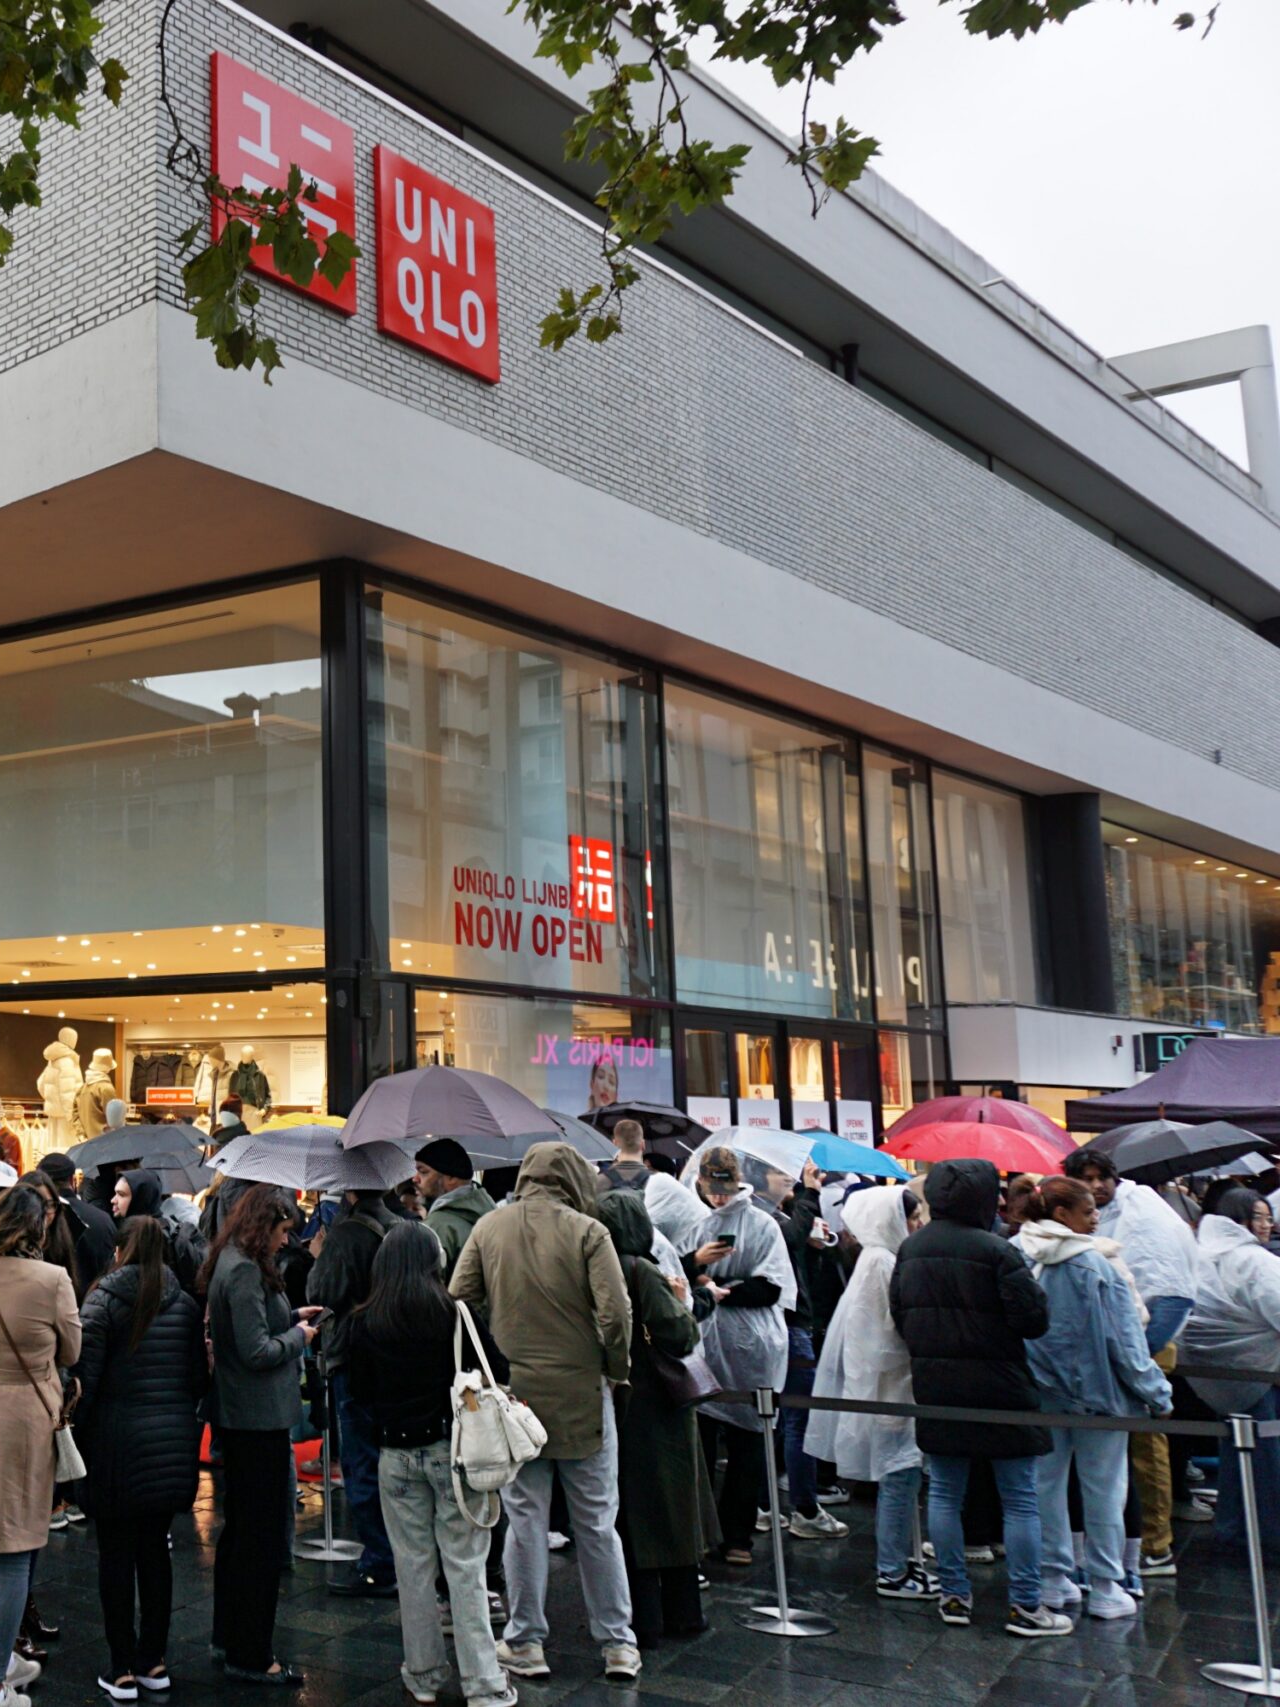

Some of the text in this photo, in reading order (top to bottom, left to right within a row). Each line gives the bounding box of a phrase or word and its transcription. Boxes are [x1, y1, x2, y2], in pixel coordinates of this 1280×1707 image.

[395, 177, 476, 277] UNI
[397, 256, 486, 349] QLO
[453, 866, 516, 902] UNIQLO
[454, 901, 603, 964] NOW OPEN
